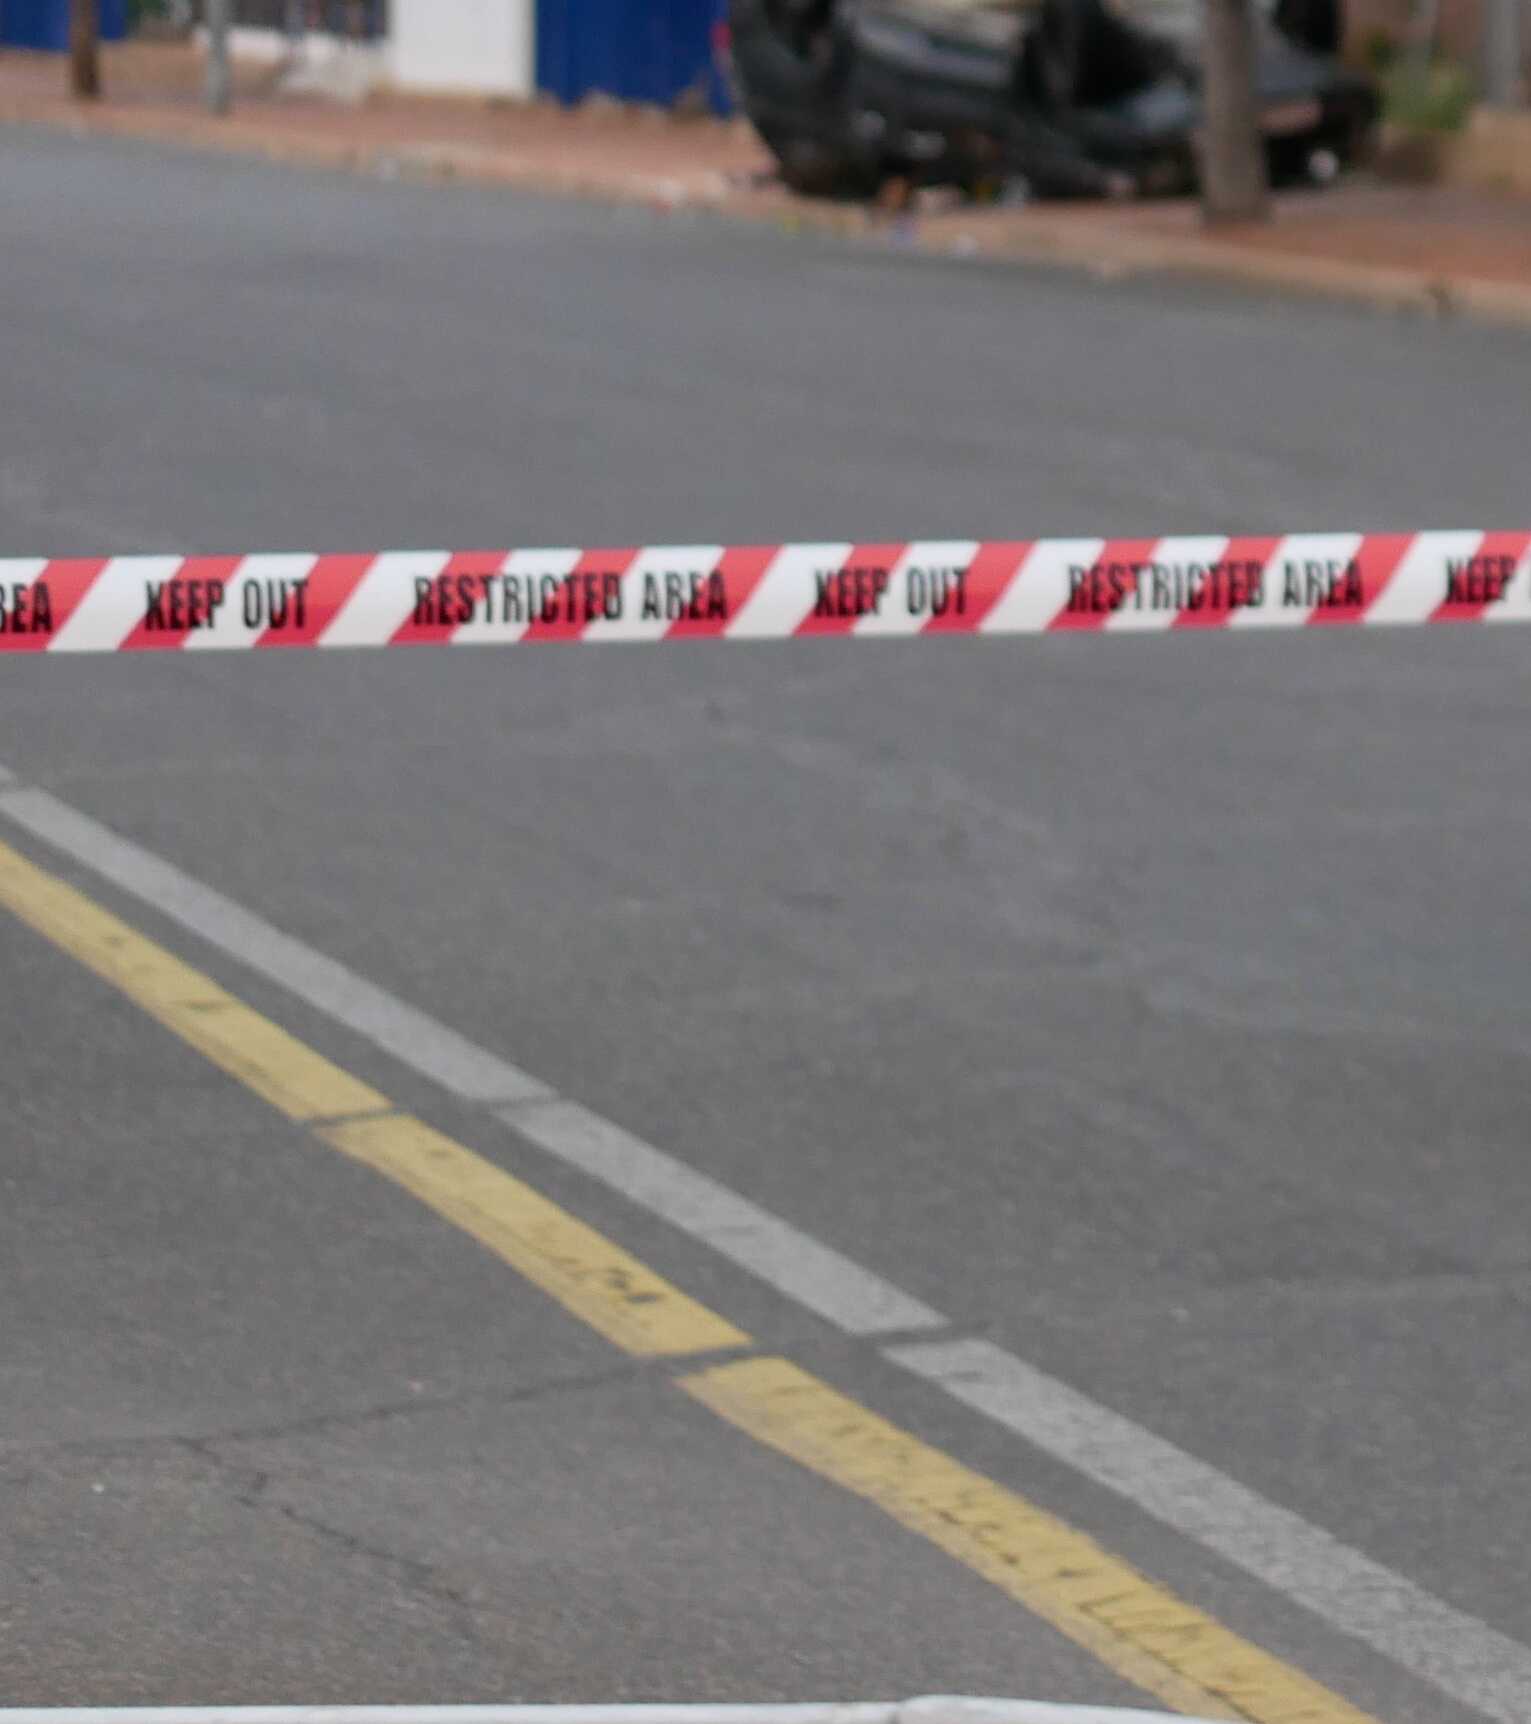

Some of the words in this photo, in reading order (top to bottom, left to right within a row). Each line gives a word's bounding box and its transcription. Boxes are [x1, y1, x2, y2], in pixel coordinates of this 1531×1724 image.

[144, 579, 224, 631] KEEP
[243, 578, 309, 629] OUT
[413, 571, 623, 626] RESTRICTED
[640, 570, 727, 622] AREA
[814, 567, 889, 616] KEEP
[907, 567, 969, 616] OUT
[1067, 561, 1263, 612] RESTRICTED
[1282, 558, 1365, 607] AREA
[1445, 555, 1516, 603] KEEP
